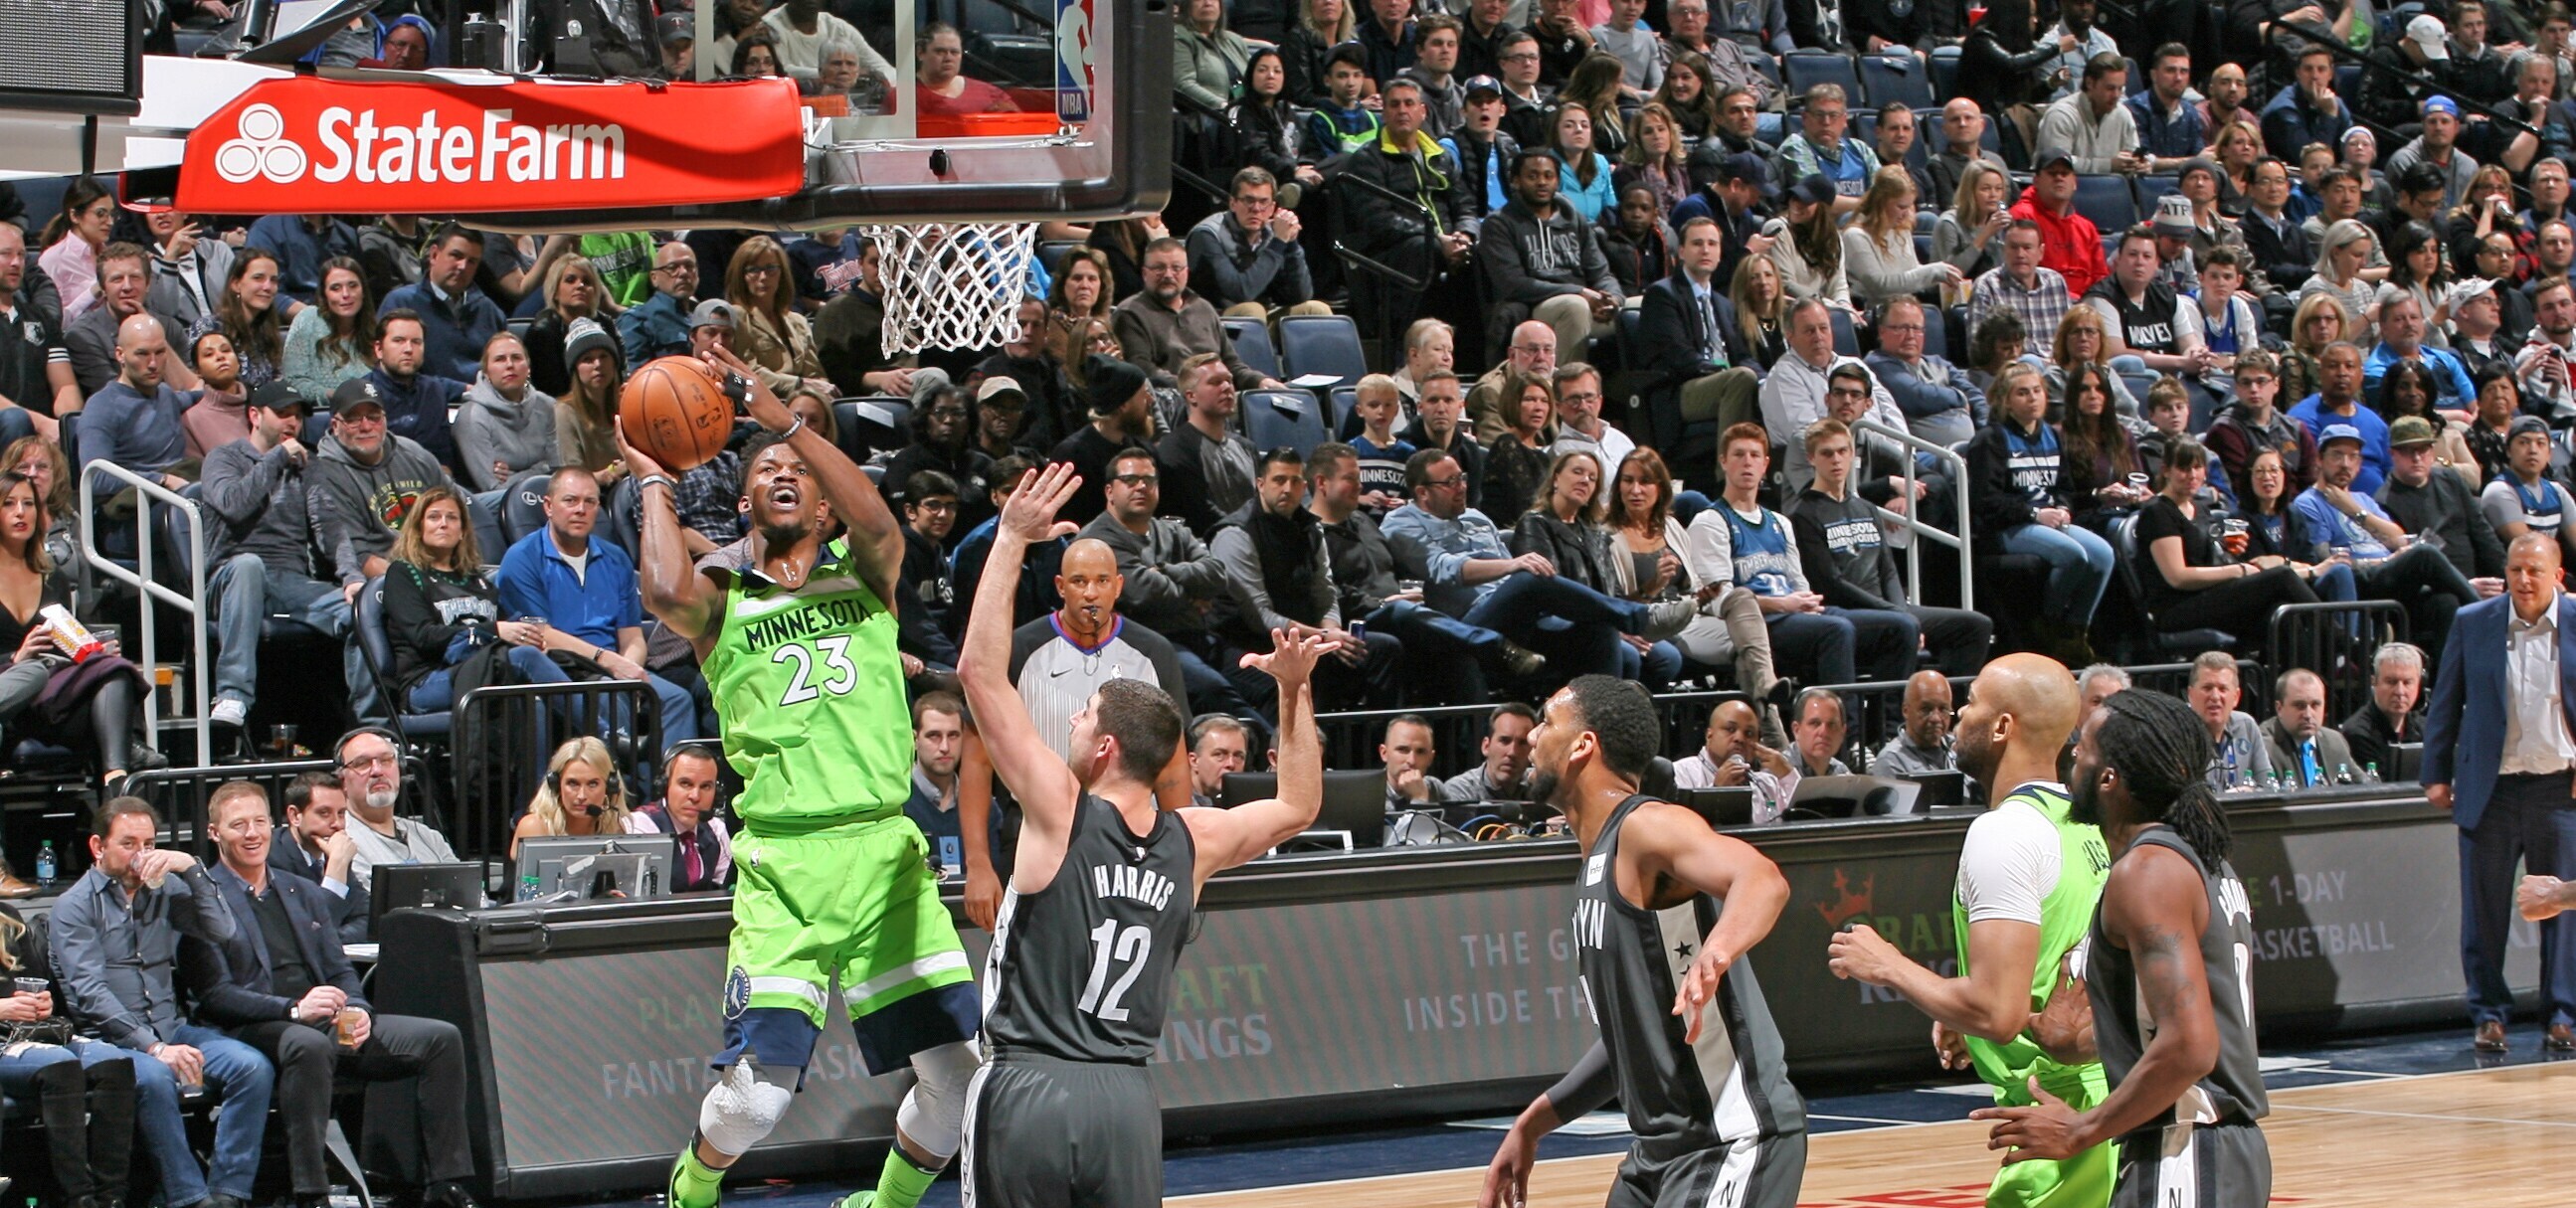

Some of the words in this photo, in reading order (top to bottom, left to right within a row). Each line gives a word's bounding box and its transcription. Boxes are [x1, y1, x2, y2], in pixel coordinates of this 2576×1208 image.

[1061, 92, 1083, 115] NBA
[744, 599, 874, 652] MINNESOTA
[771, 635, 857, 707] 23
[1094, 864, 1176, 912] HARRIS
[2270, 871, 2347, 907] 1-DAY
[1460, 931, 1531, 968] THE
[2251, 921, 2395, 962] ASKETBALL
[1077, 918, 1152, 1022] 12
[1169, 962, 1269, 1014] AFT
[638, 994, 722, 1035] PLA
[1403, 989, 1532, 1032] INSIDE
[1546, 985, 1589, 1020] TH
[1720, 1179, 1737, 1208] N
